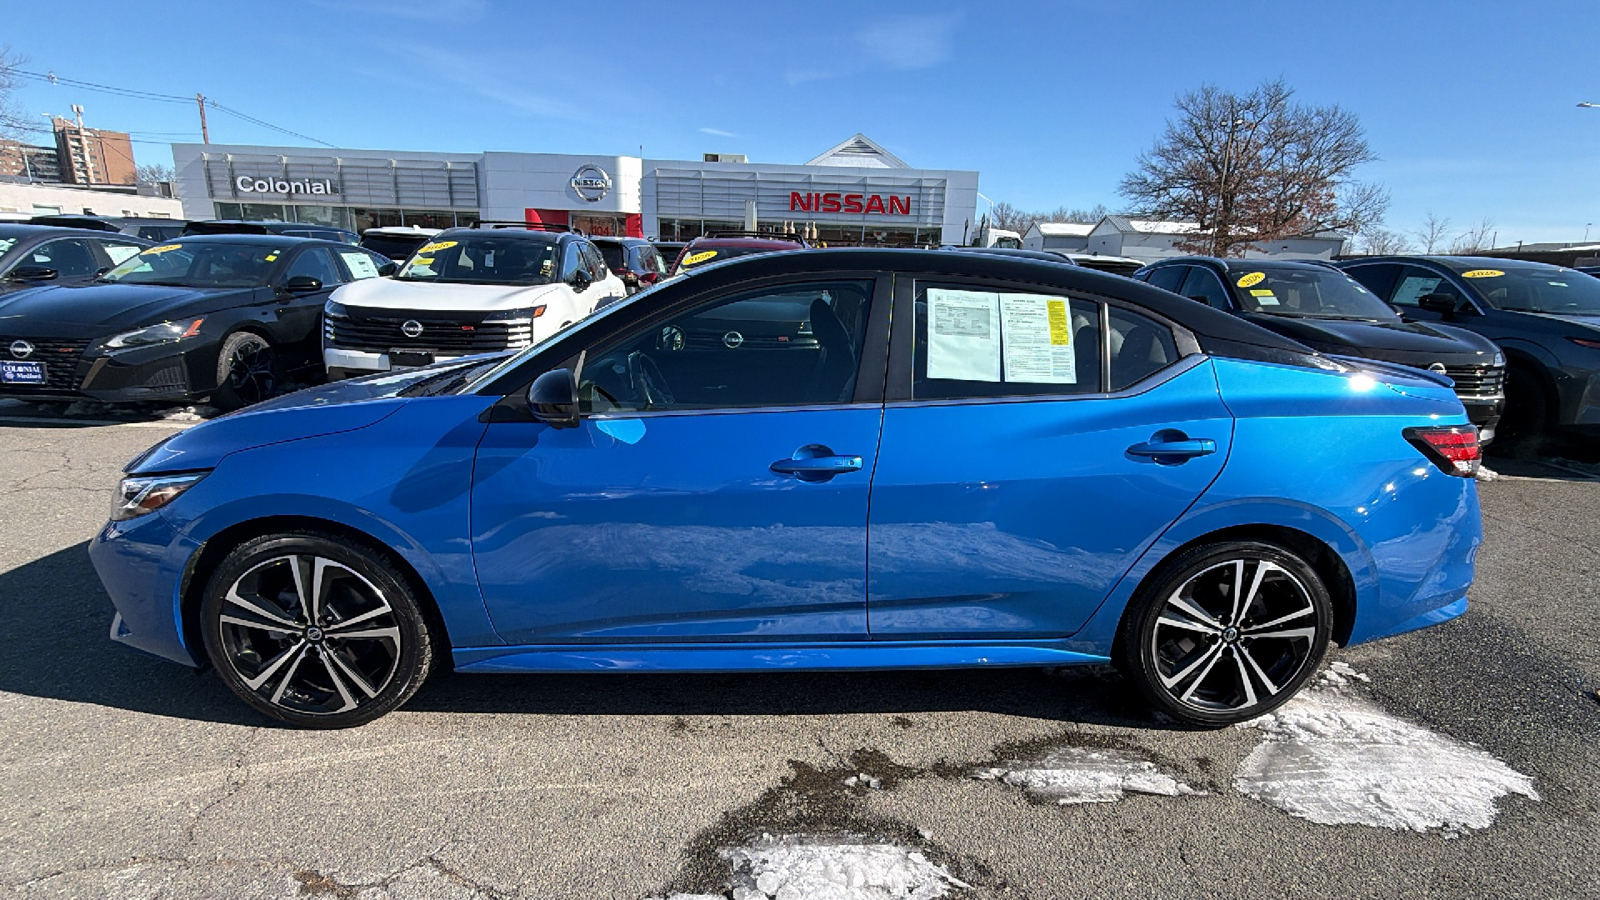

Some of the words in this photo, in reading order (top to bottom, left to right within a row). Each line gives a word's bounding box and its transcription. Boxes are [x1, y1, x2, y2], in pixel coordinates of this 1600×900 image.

[236, 175, 332, 195] Colonial
[574, 179, 607, 187] NISSAN
[789, 191, 911, 215] NISSAN
[2, 365, 43, 373] COLONIAL
